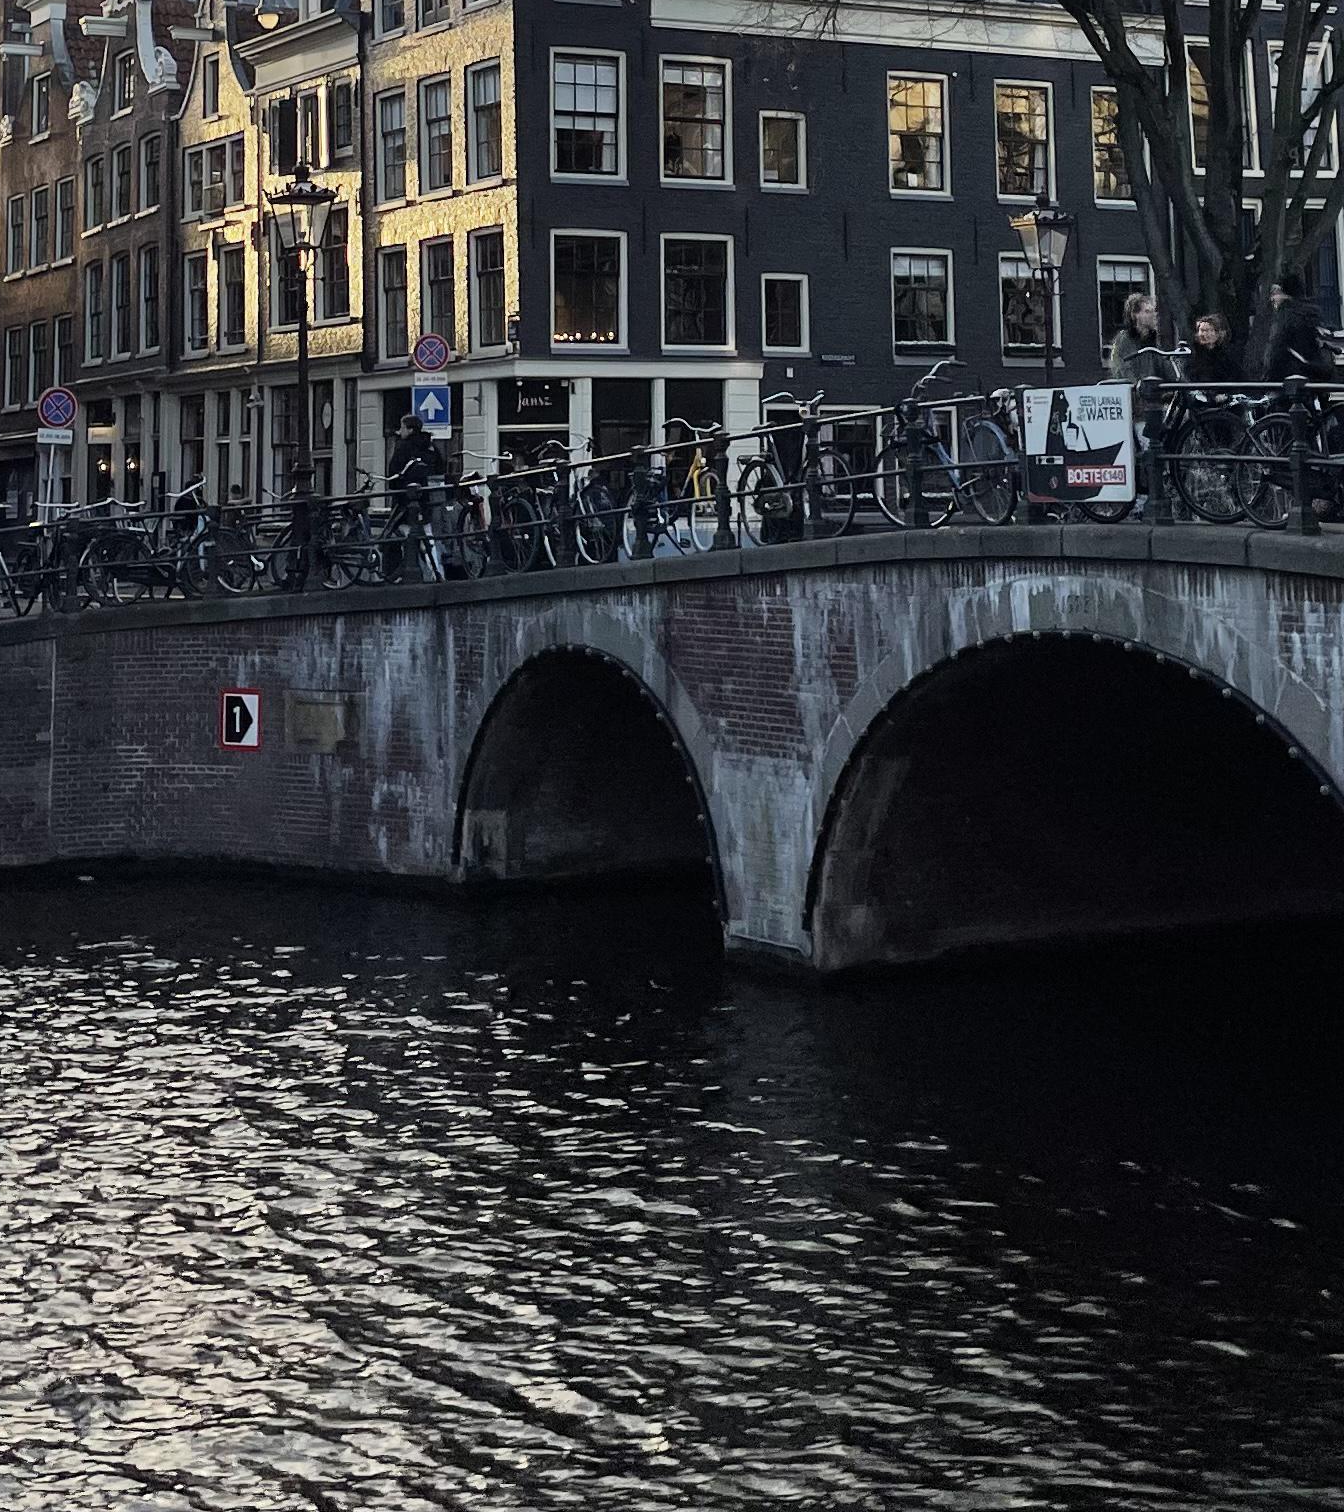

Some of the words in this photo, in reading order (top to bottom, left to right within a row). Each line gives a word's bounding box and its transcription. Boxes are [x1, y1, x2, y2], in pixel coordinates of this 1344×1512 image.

[1086, 407, 1124, 421] WATER
[1067, 468, 1101, 484] BOETE
[233, 705, 241, 733] 1
